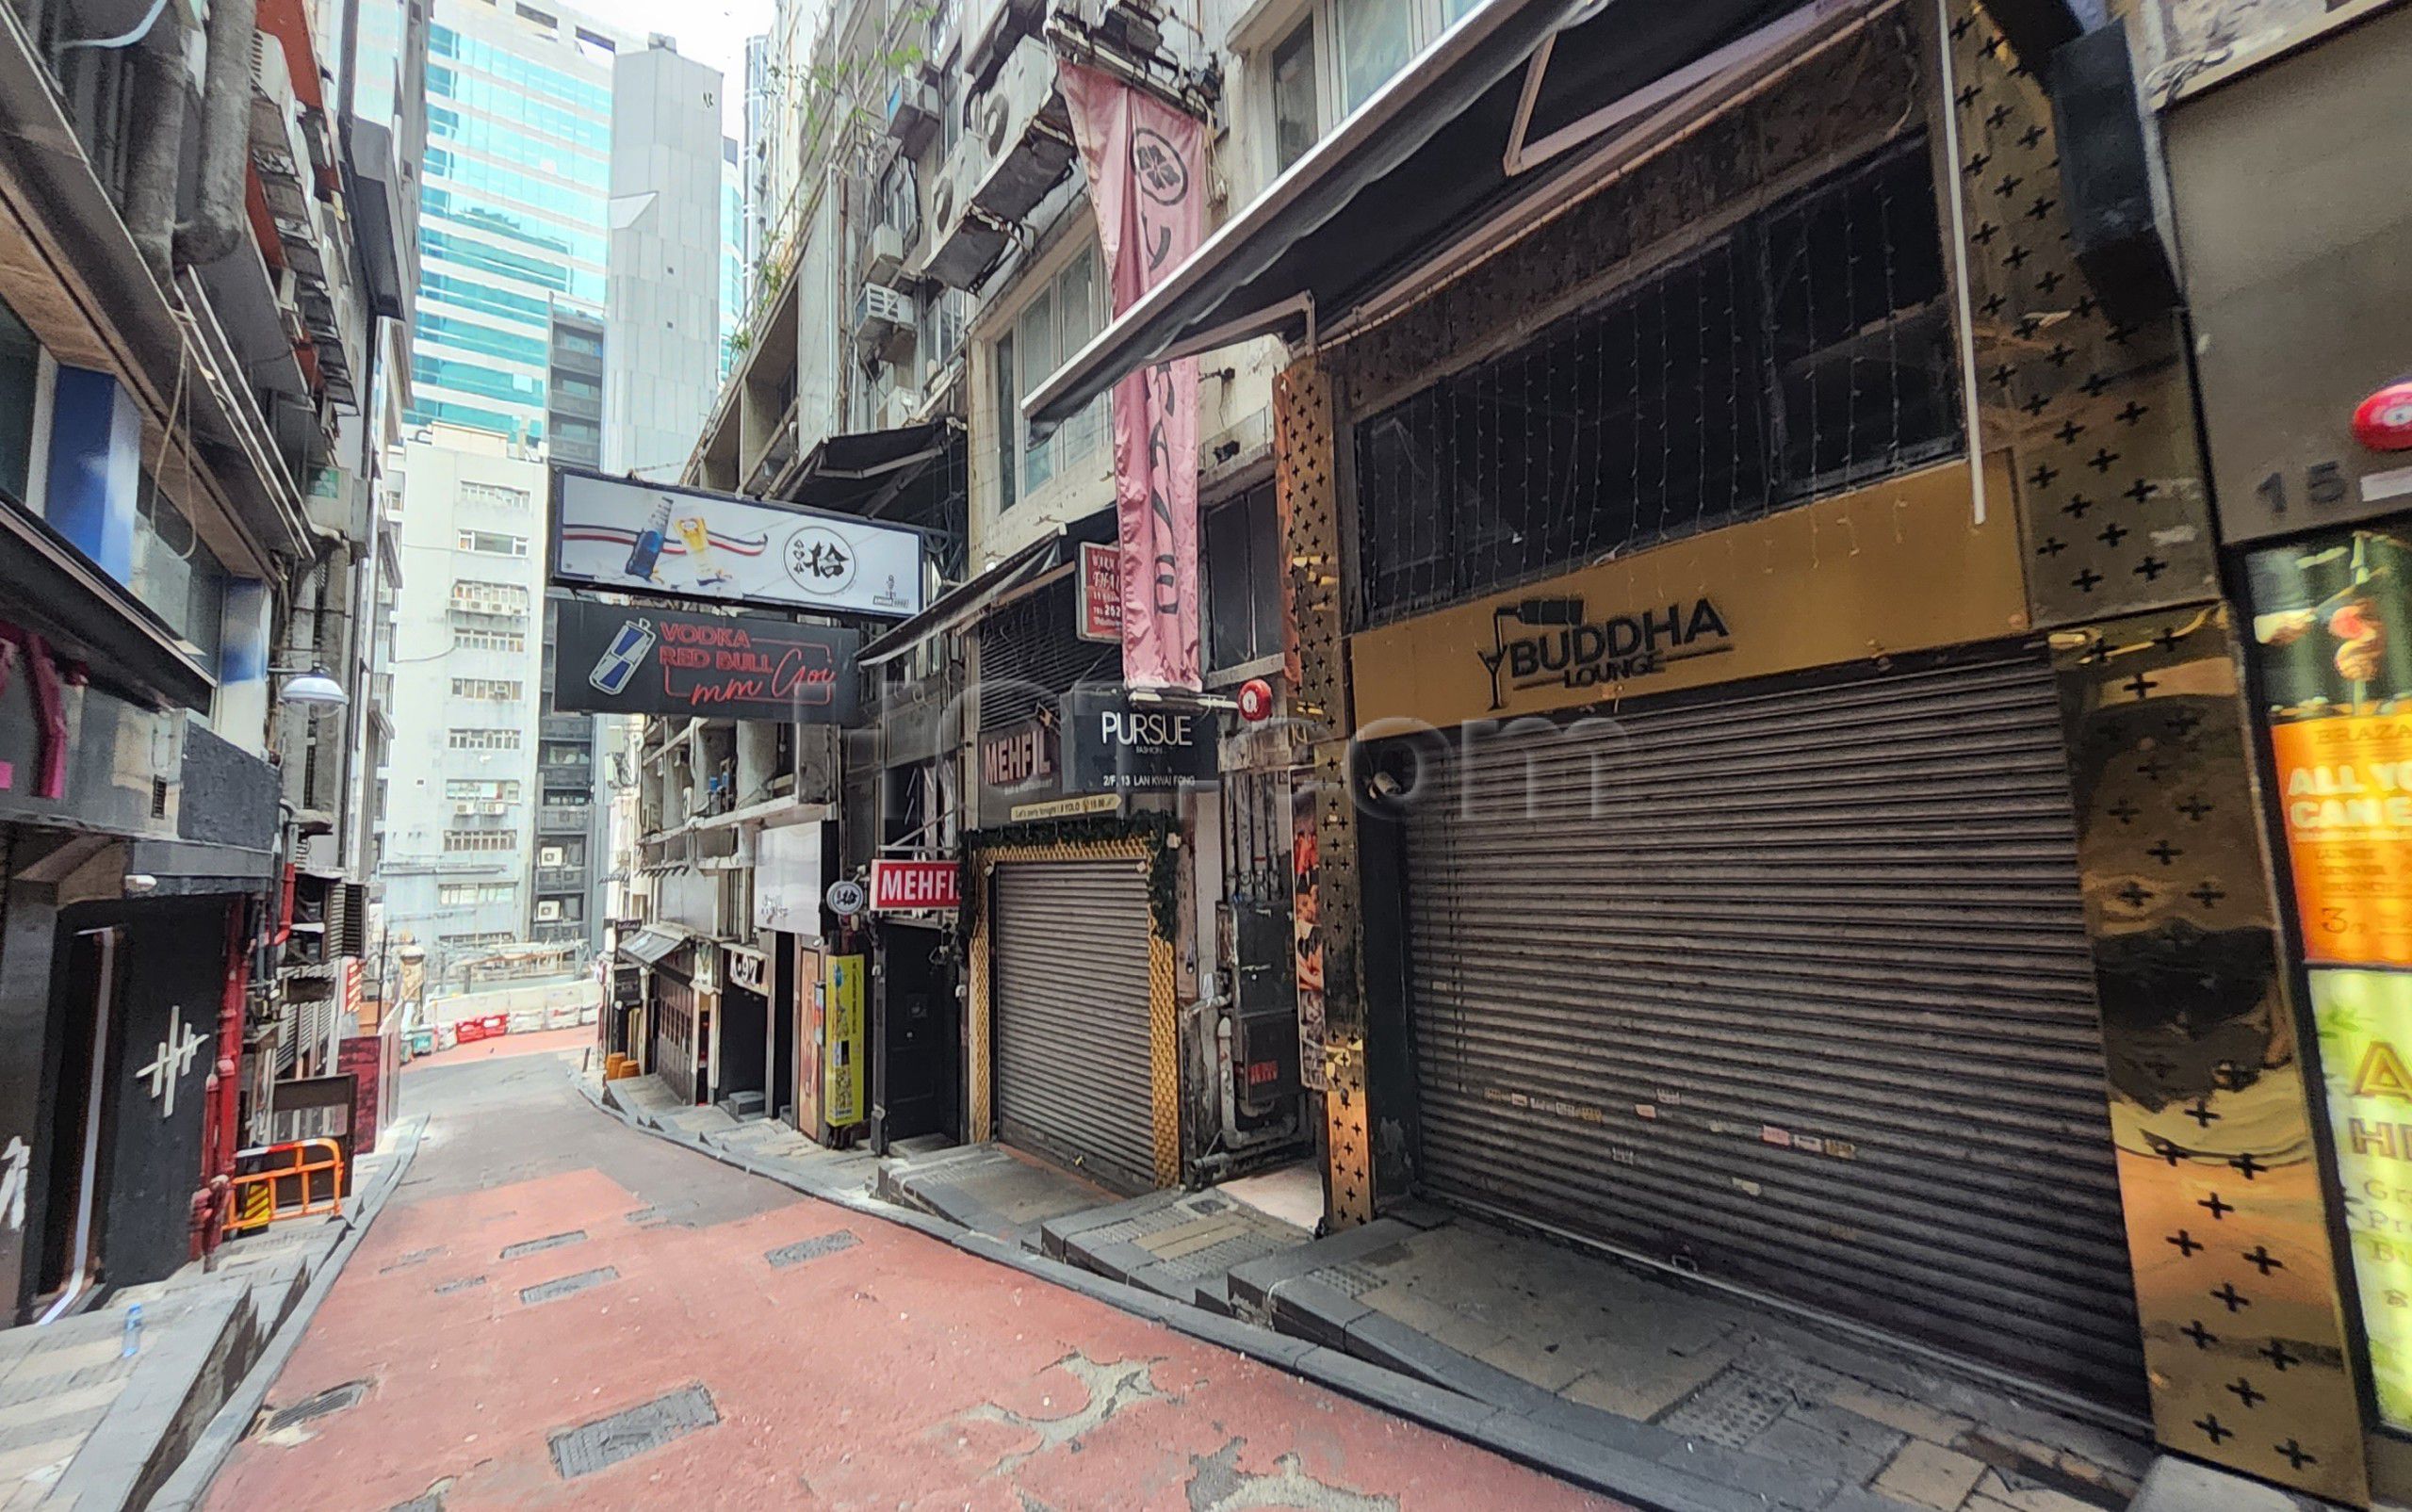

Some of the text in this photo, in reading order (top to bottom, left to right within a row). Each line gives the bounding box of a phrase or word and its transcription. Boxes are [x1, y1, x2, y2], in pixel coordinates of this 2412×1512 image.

[2257, 460, 2347, 514] 15
[660, 622, 751, 648] VODKA
[1510, 597, 1730, 678] BUDDHA
[660, 645, 774, 675] RED BULL
[1564, 650, 1666, 689] LOUNGE
[1101, 710, 1193, 746] PURSUE
[984, 730, 1051, 786] MEHFIL
[1121, 774, 1131, 787] 13
[1133, 774, 1150, 787] LAN
[1151, 774, 1171, 787] KWAI
[1173, 774, 1196, 787] FONG
[2287, 764, 2368, 796] ALL
[2290, 798, 2383, 829] CAN
